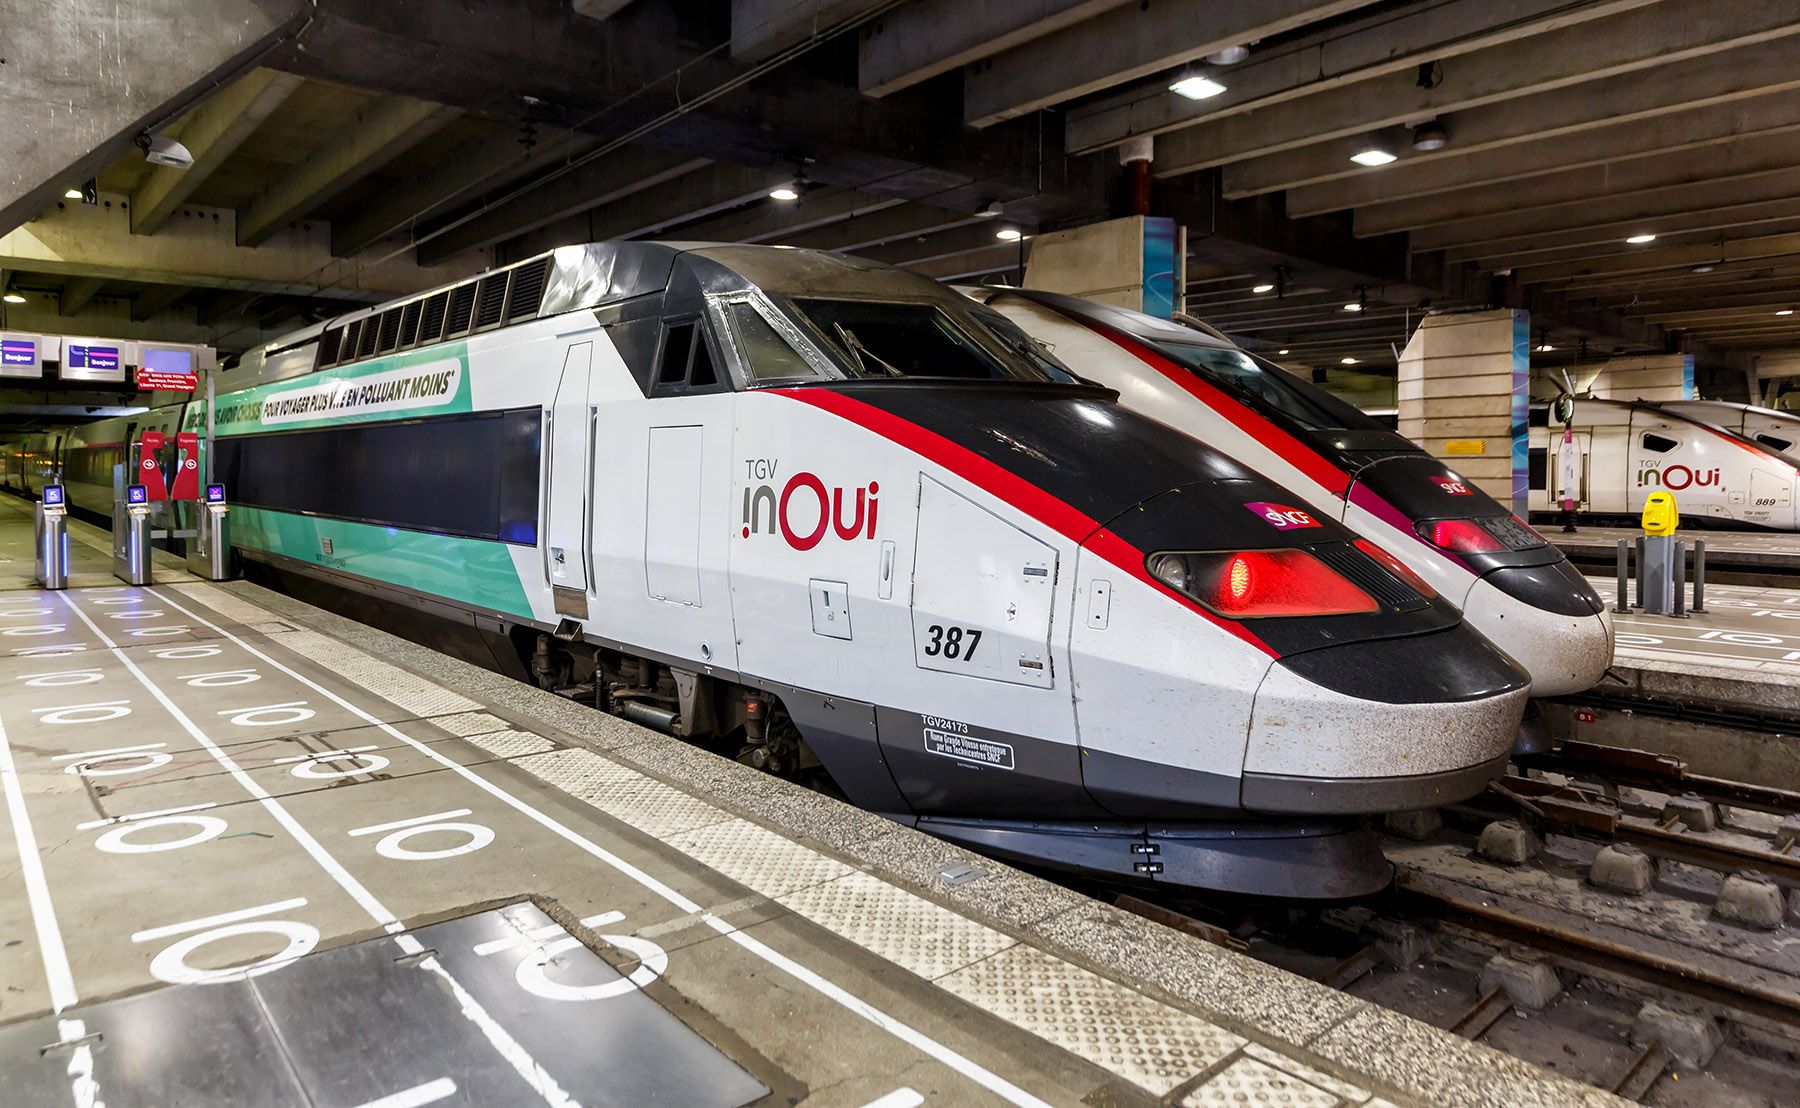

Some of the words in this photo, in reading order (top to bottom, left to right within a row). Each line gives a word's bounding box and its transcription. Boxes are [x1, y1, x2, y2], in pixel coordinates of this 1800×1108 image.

[5, 353, 32, 362] Bonjour
[91, 359, 116, 367] Bonjour
[263, 400, 280, 418] POUR
[280, 396, 310, 416] VOYAGER
[309, 393, 329, 412] PLUS
[346, 387, 360, 407] EN
[359, 378, 411, 406] POLLUANT
[745, 458, 778, 480] TGV
[1639, 459, 1661, 468] TGV
[1755, 498, 1776, 506] 889
[1265, 511, 1310, 527] SNCF
[924, 624, 983, 662] 387
[921, 714, 968, 734] TGV24173
[930, 731, 944, 742] Rame
[944, 733, 960, 746] Grande
[960, 736, 979, 750] Vitesse
